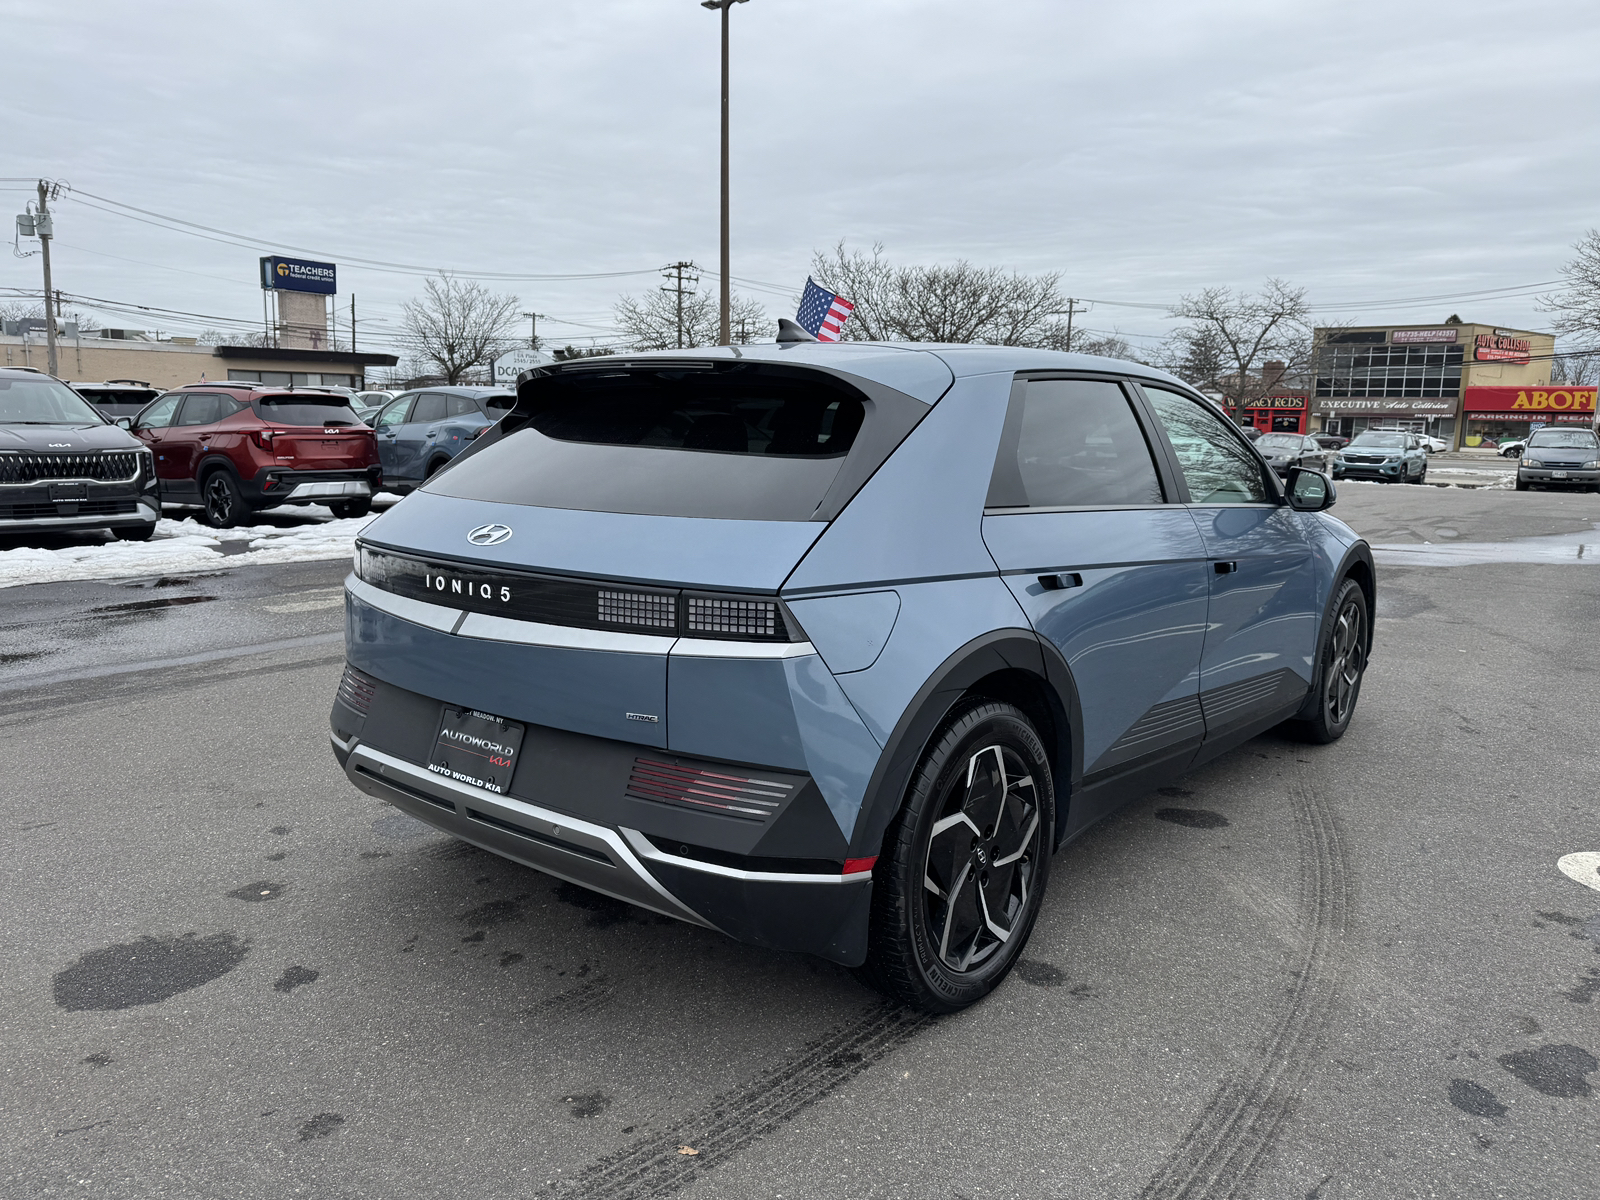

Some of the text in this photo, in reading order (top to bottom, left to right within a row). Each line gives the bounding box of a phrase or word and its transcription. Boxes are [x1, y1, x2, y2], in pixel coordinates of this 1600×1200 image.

[289, 264, 334, 277] TEACHERS
[1275, 397, 1303, 407] REDS
[1320, 400, 1449, 409] EXECUTIVE Auto Collision
[426, 574, 511, 602] IONIQ 5
[627, 714, 657, 722] HTRAC
[440, 728, 514, 757] AUTOWORLD
[1012, 723, 1044, 761] MICHELIN
[428, 763, 502, 793] AUTO WORLD KIA
[929, 967, 972, 997] MICHELIN
